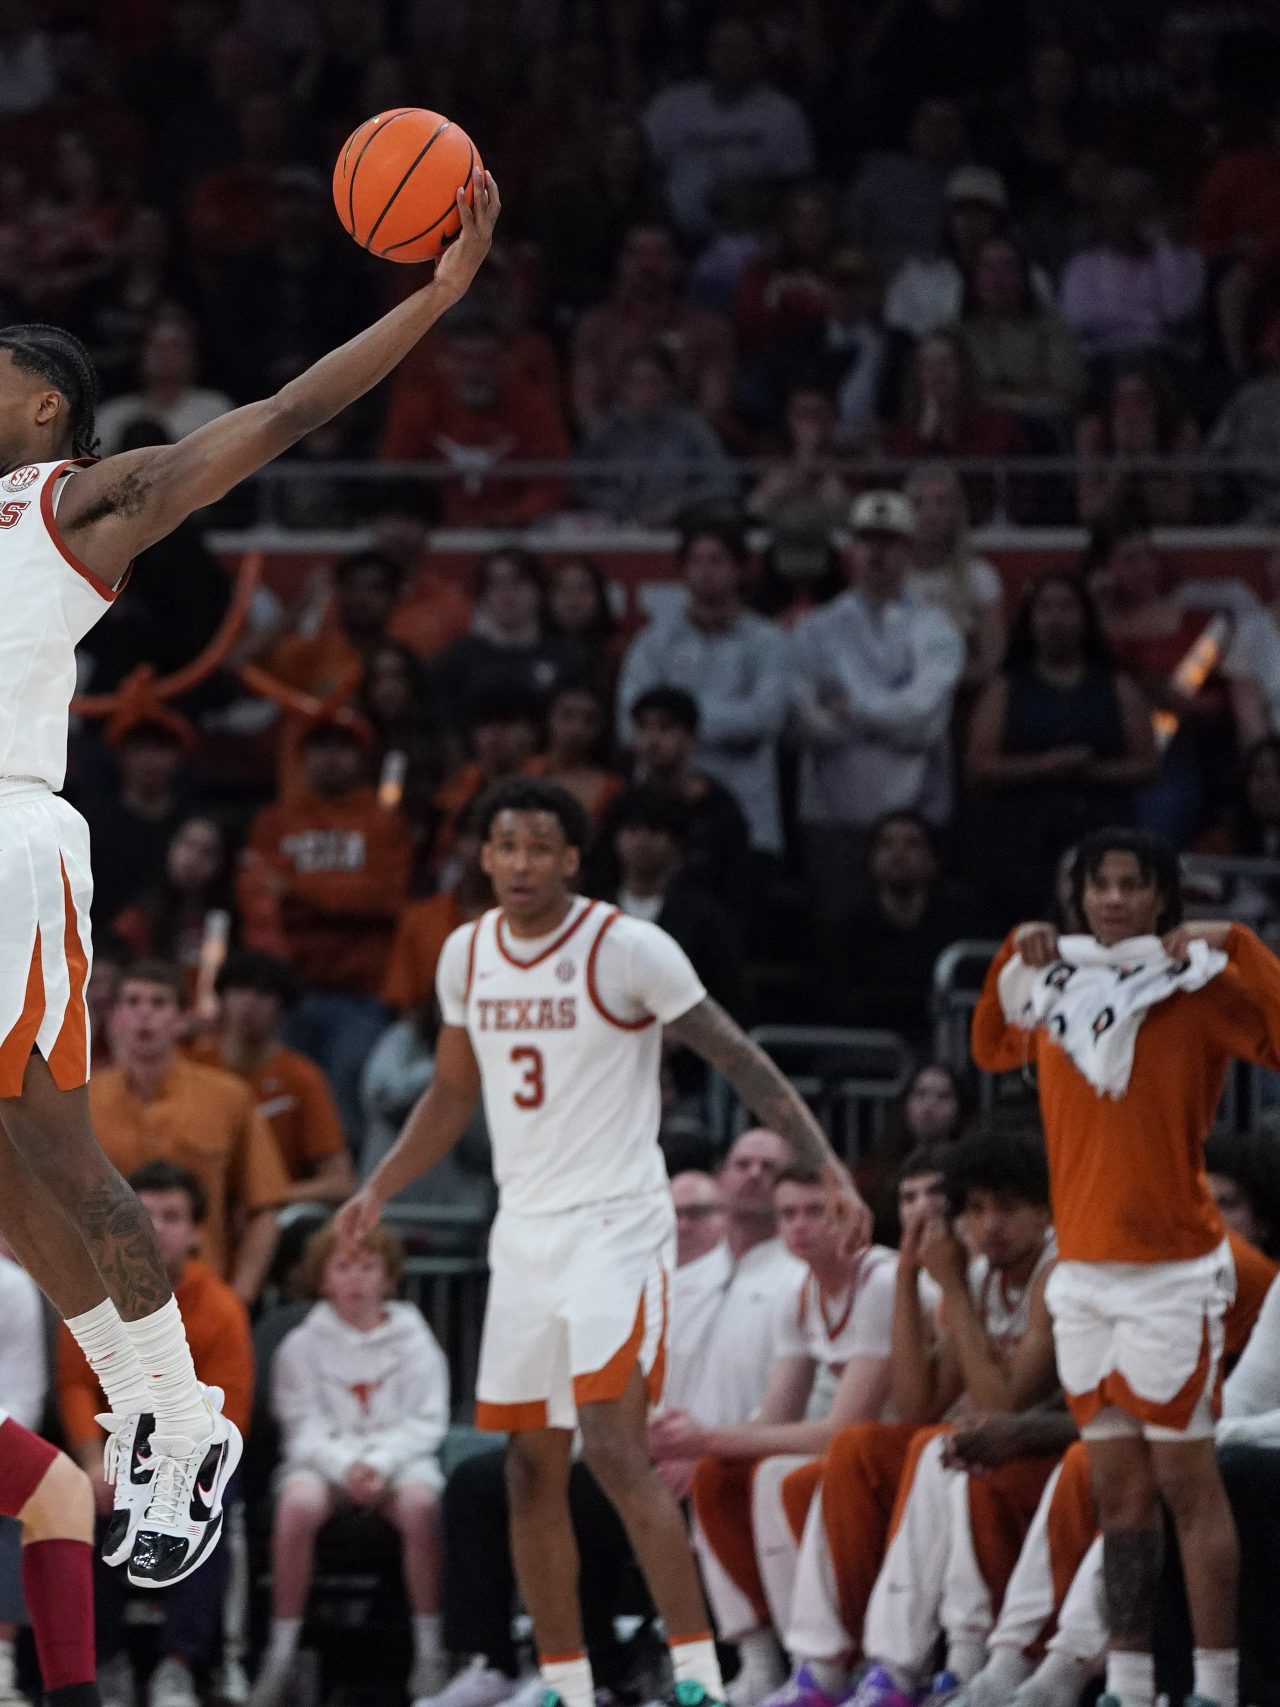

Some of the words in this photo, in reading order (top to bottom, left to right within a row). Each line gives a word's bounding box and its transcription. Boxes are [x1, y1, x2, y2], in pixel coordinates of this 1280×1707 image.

[10, 466, 40, 486] SEC
[477, 997, 577, 1032] TEXAS
[510, 1045, 544, 1109] 3
